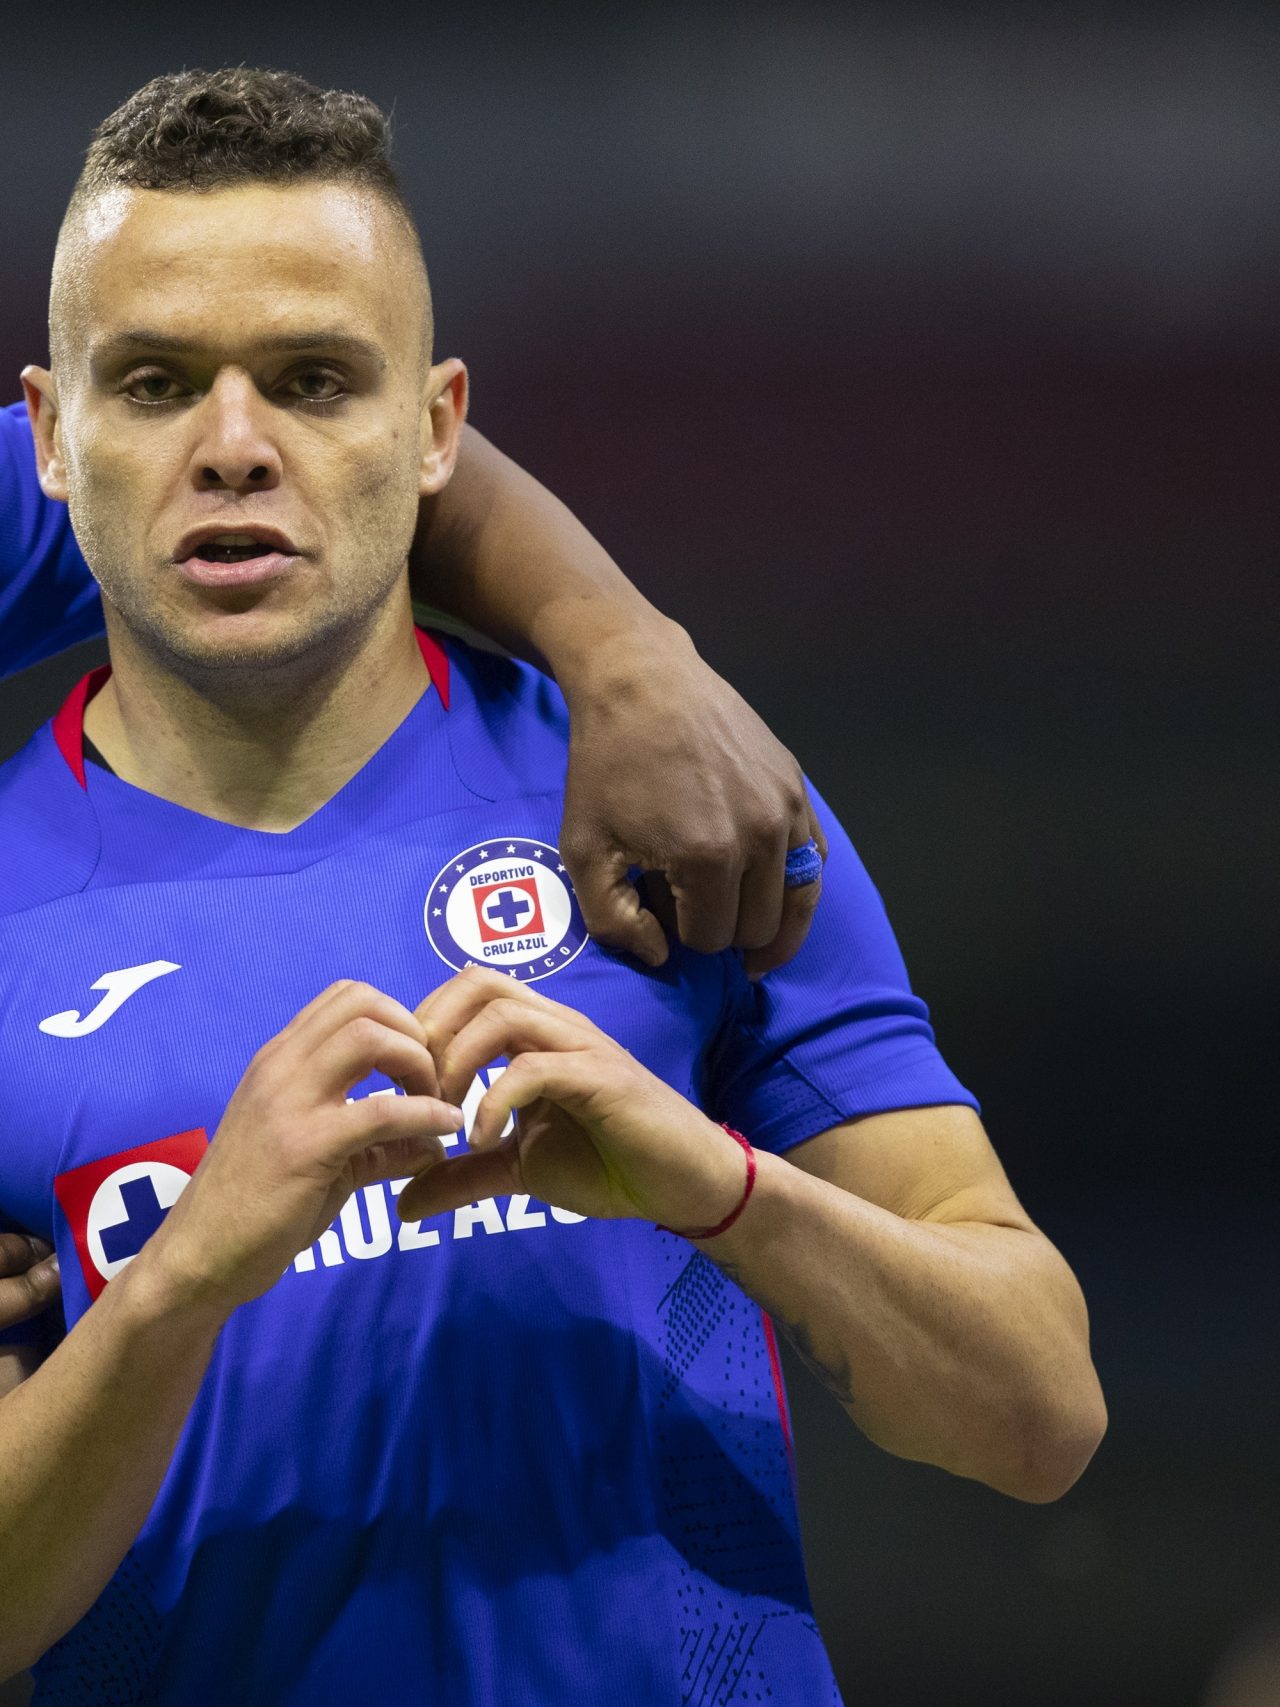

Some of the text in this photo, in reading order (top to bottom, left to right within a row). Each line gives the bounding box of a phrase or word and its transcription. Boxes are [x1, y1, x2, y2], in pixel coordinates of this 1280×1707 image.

[470, 865, 535, 887] DEPORTIVO
[483, 937, 548, 957] CRUZ AZUL
[464, 946, 571, 980] XICO
